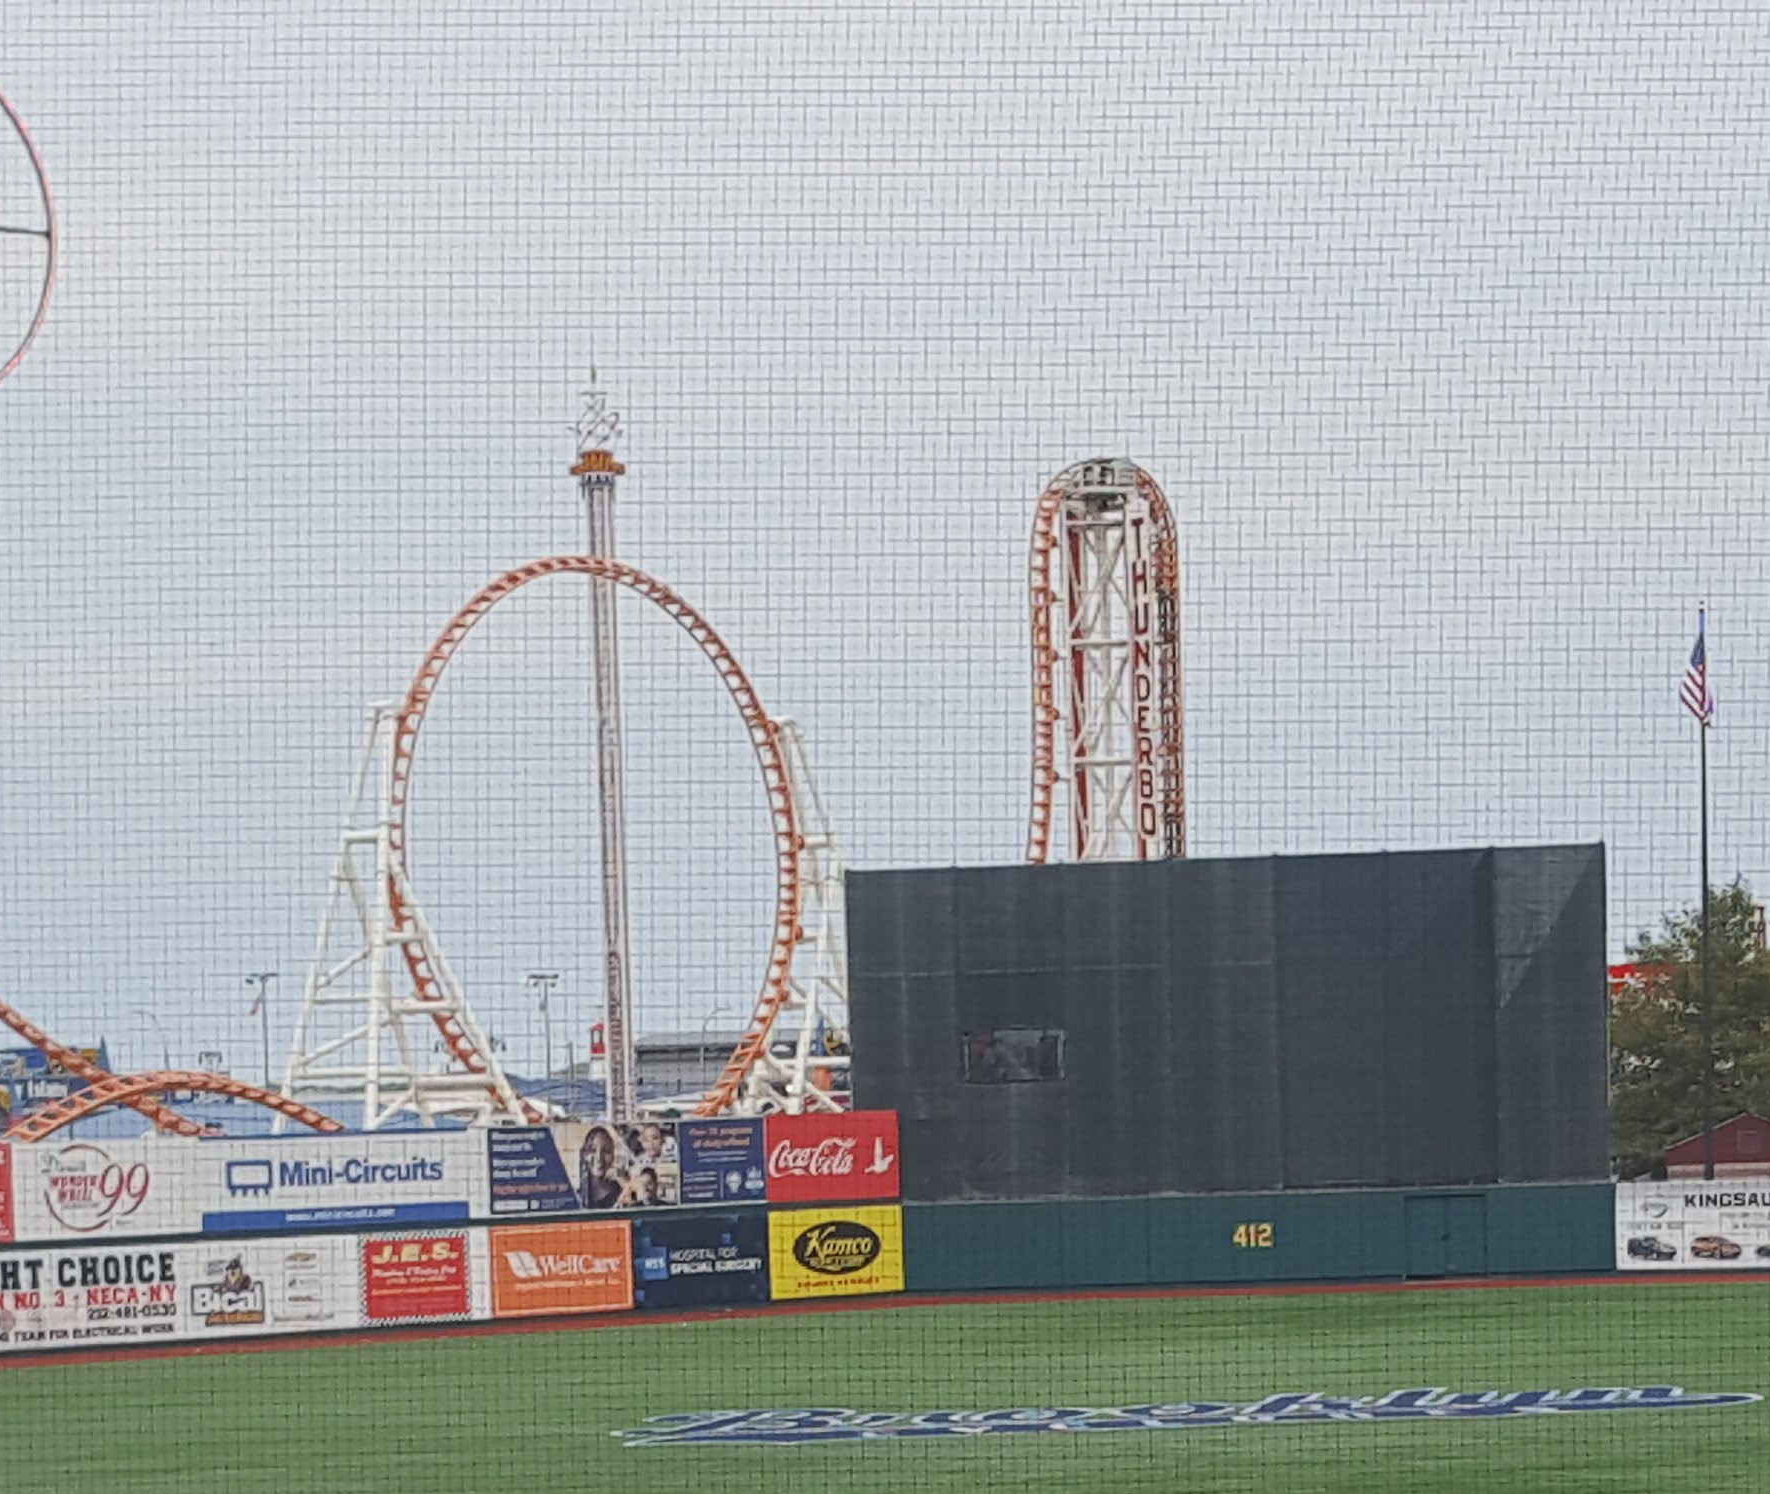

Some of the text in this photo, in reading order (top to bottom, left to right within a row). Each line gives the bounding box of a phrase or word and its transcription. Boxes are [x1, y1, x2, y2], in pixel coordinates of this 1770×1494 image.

[279, 1157, 443, 1187] Mini-Circuits
[97, 1162, 150, 1217] 99
[805, 1226, 873, 1259] Kamco
[1232, 1222, 1275, 1249] 412
[372, 1241, 460, 1263] J.E.S.
[538, 1254, 621, 1277] WellCare
[669, 1248, 715, 1262] HOSPITAL
[57, 1252, 176, 1287] CHOICE
[670, 1258, 762, 1276] SPECIAL SURGERY
[54, 1290, 66, 1308] 3
[86, 1284, 178, 1306] NECA-NY
[610, 1386, 1767, 1448] Brooklyn
